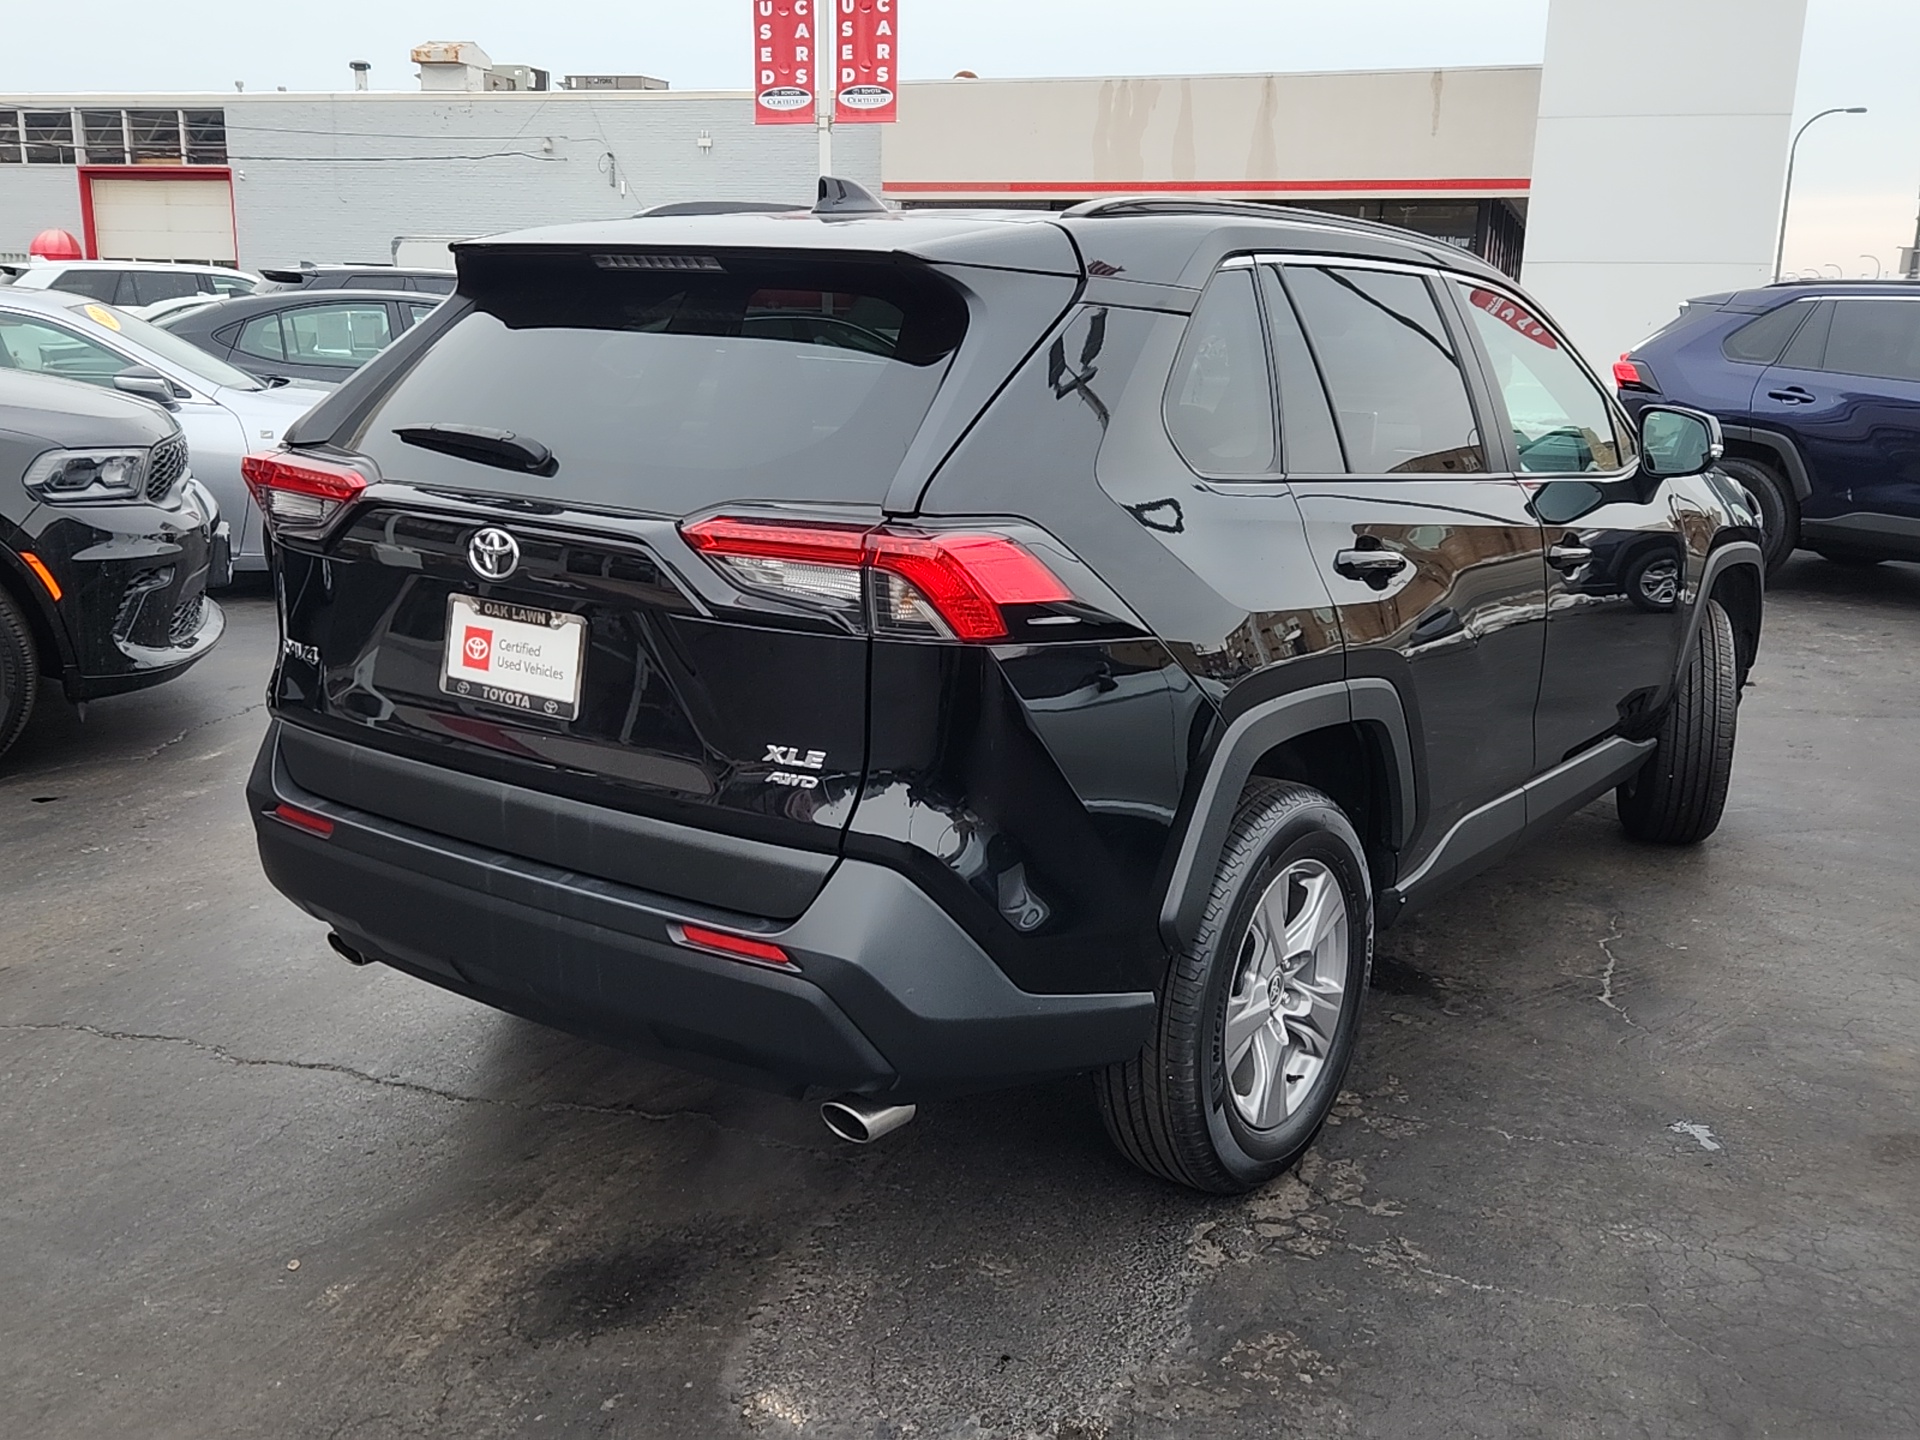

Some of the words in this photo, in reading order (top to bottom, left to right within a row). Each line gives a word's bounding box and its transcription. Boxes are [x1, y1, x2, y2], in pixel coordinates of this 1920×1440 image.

[759, 1, 775, 85] USED
[794, 1, 810, 84] CARS
[842, 0, 856, 83] USED
[875, 0, 892, 82] CARS
[484, 603, 509, 618] OAK
[512, 607, 546, 625] LAWN
[499, 639, 542, 657] Certified
[497, 656, 522, 672] Used
[523, 661, 564, 680] Vehicles
[482, 686, 530, 709] TOYOTA
[762, 744, 827, 769] XLE
[764, 771, 819, 789] AWD
